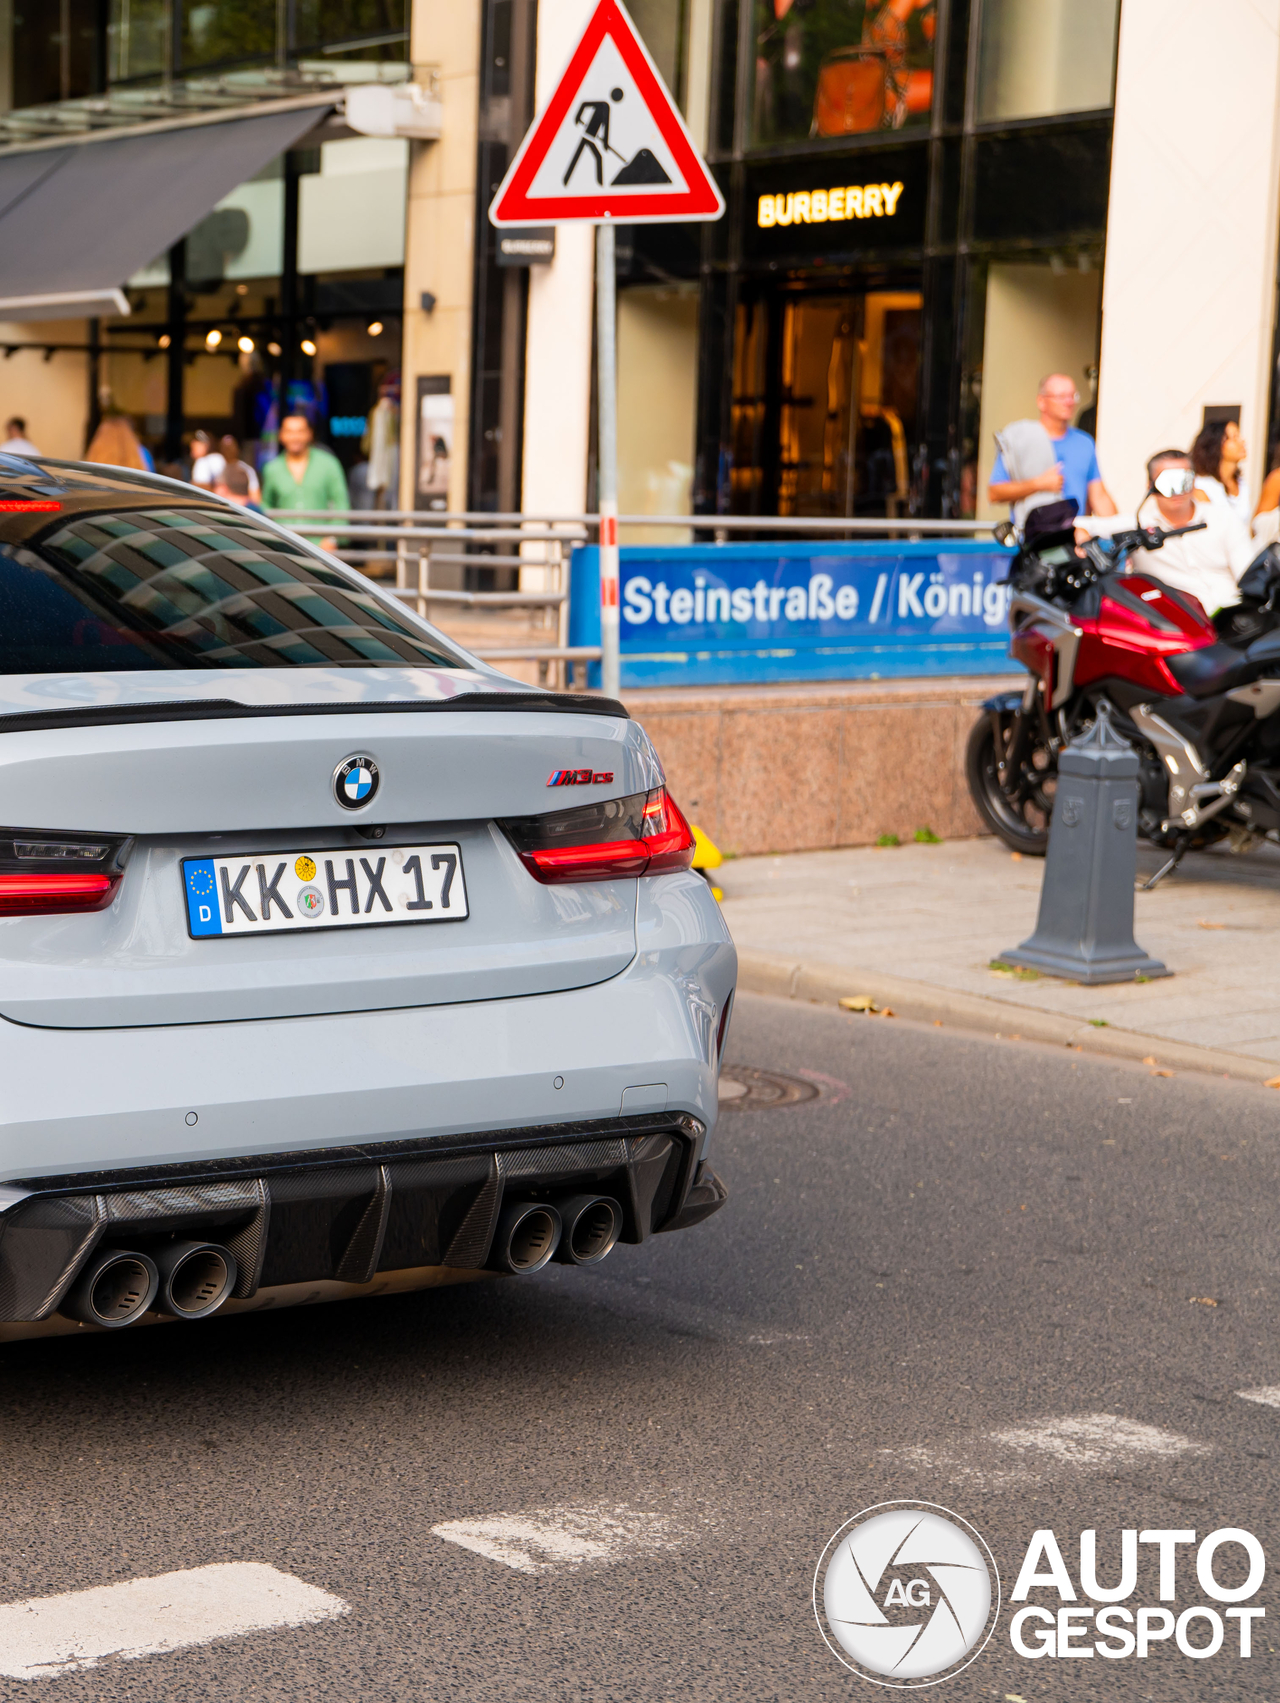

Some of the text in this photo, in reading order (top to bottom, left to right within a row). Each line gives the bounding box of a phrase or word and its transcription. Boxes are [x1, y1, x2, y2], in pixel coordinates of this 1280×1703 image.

[757, 182, 905, 228] BURBERRY
[622, 574, 859, 625] Steinstraße
[868, 573, 888, 624] /
[341, 758, 378, 776] BMW
[199, 905, 212, 922] D
[219, 863, 294, 924] KK
[324, 856, 393, 916] HX
[402, 853, 457, 910] 17
